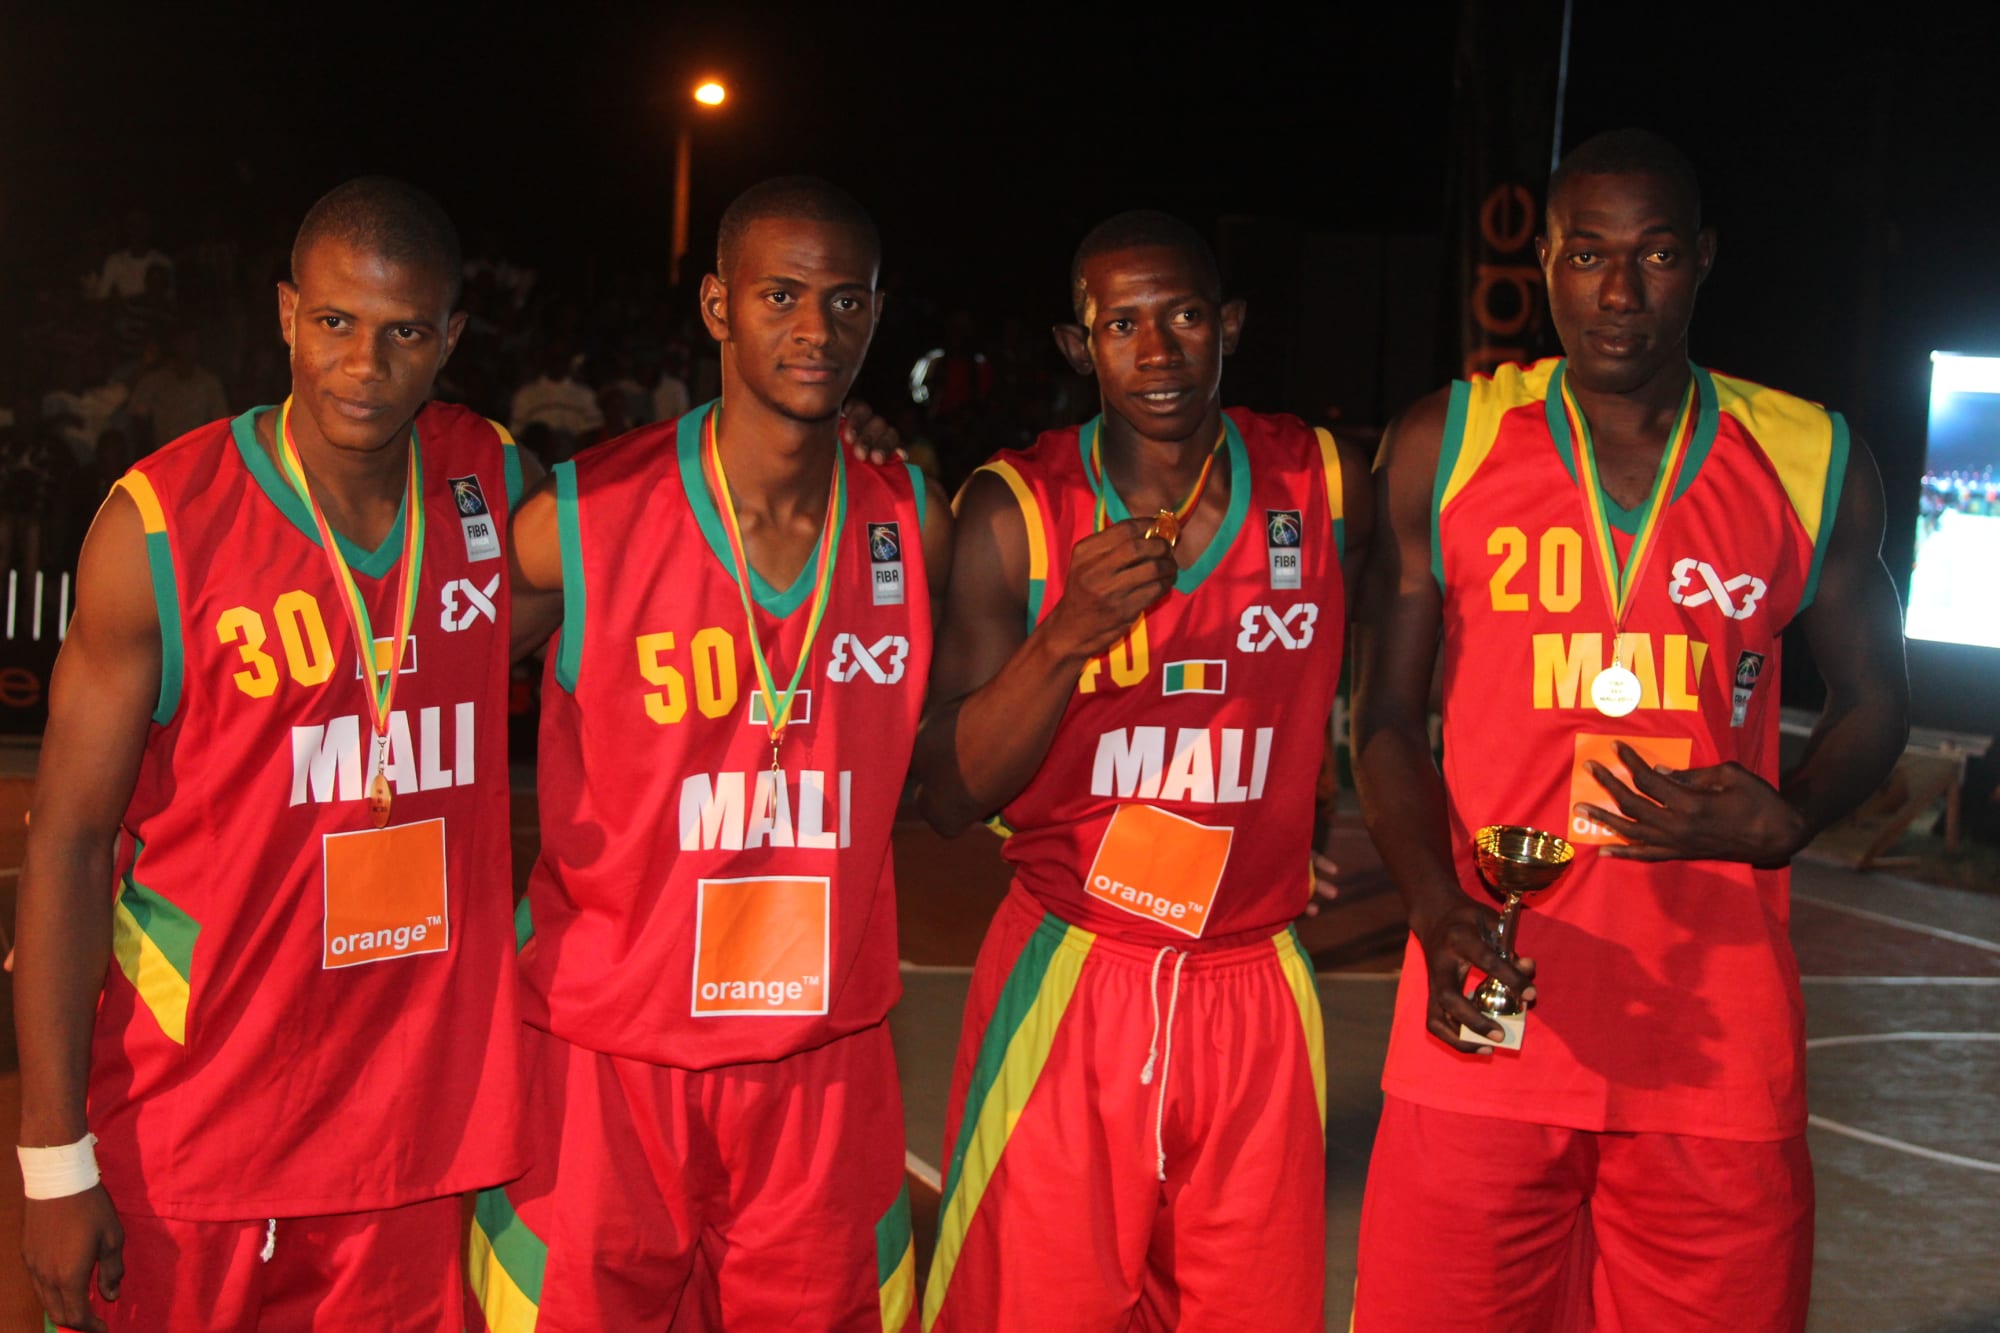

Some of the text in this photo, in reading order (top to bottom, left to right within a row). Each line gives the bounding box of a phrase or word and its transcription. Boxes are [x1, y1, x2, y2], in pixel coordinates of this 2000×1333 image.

[467, 523, 489, 539] FIBA
[1274, 555, 1296, 568] FIBA
[1487, 526, 1583, 613] 20
[876, 569, 899, 584] FIBA
[215, 589, 336, 699] 30
[636, 626, 738, 725] 50
[289, 701, 476, 807] MALI
[1091, 725, 1273, 803] MALI
[679, 768, 852, 851] MALI
